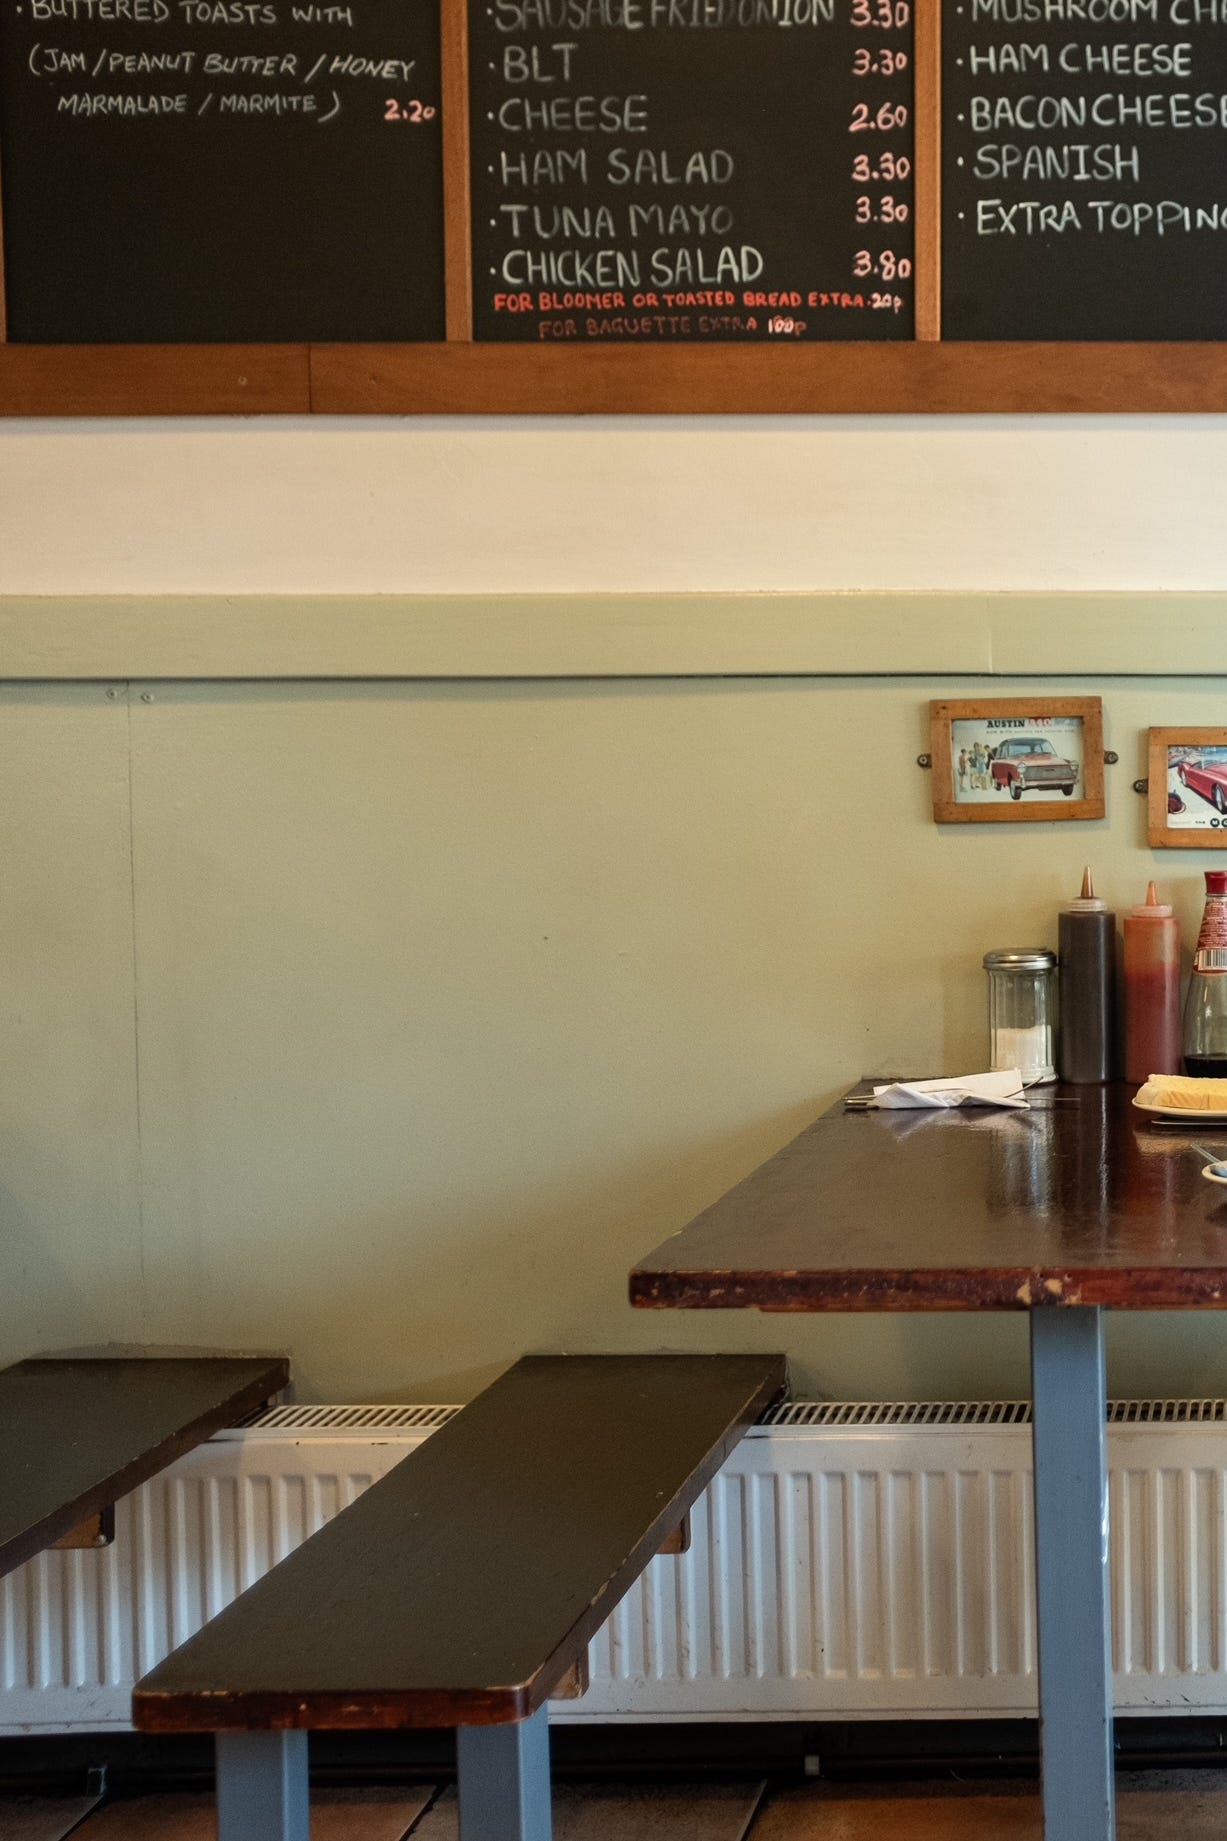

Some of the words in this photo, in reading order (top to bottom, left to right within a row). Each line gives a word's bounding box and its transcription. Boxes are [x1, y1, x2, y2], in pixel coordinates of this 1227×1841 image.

[31, 0, 169, 22] BUTTERED
[181, 0, 277, 25] TOASTS
[292, 5, 353, 27] WITH
[850, 0, 909, 29] 3.30
[972, 0, 1158, 22] MUSHROOM
[203, 53, 297, 76] BUTTER
[504, 42, 578, 83] BLT
[852, 49, 908, 76] 3.30
[970, 43, 1049, 75] HAM
[1059, 43, 1192, 77] CHEESE
[58, 93, 187, 116] MARMALADE
[384, 98, 435, 123] 2.20
[499, 95, 648, 133] CHEESE
[848, 102, 907, 132] 2.60
[971, 95, 1086, 132] BACON
[501, 148, 587, 186] HAM
[608, 148, 734, 184] SALAD
[852, 152, 910, 182] 3.30
[973, 144, 1139, 182] SPANISH
[500, 204, 616, 239] TUNA
[629, 204, 733, 237] MAYO
[856, 196, 908, 223] 3.30
[977, 199, 1081, 235] EXTRA
[502, 250, 640, 288] CHICKEN
[651, 245, 763, 287] SALAD
[853, 250, 911, 280] 3.80
[494, 293, 534, 313] FOR
[538, 292, 625, 311] BLOOMER
[632, 293, 659, 308] OR
[662, 291, 735, 307] TOASTED
[742, 291, 802, 307] BREAD
[808, 292, 865, 308] EXTRA
[538, 319, 578, 339] FOR
[585, 317, 690, 336] BAGUETTE
[699, 316, 758, 333] EXTRA
[986, 719, 1025, 728] AUSTIN
